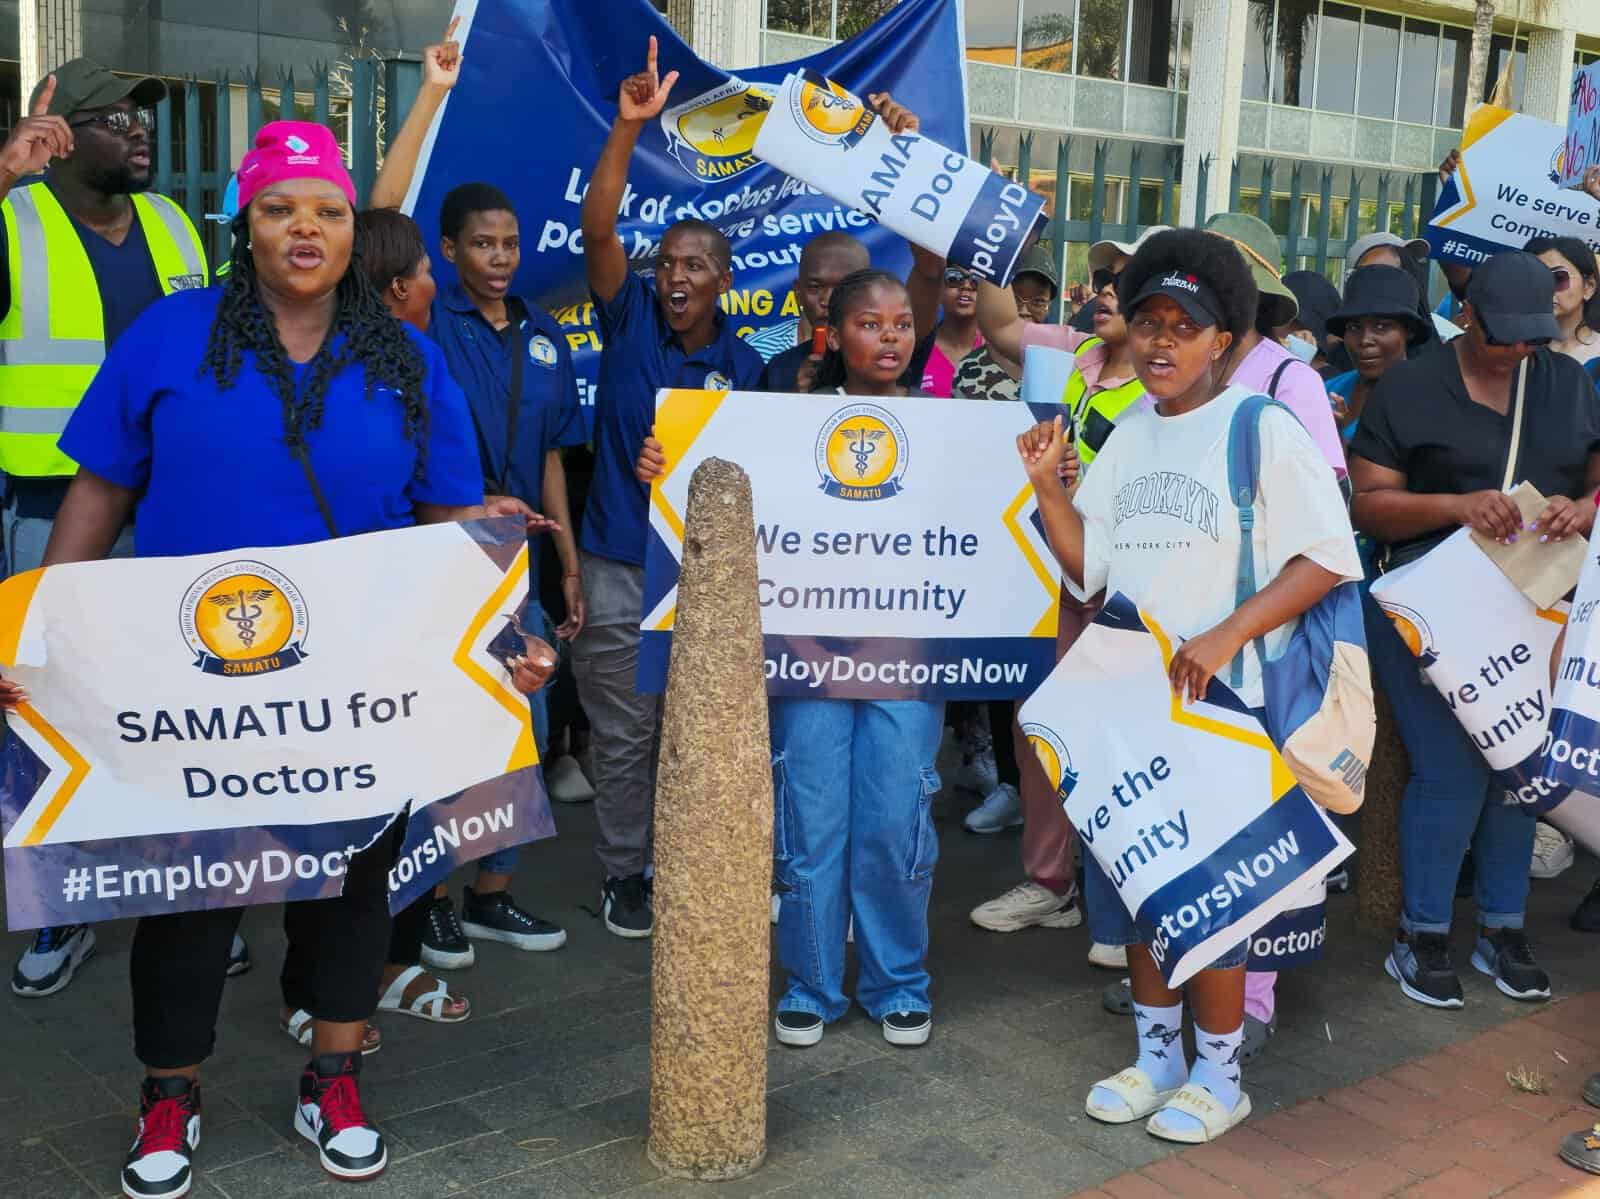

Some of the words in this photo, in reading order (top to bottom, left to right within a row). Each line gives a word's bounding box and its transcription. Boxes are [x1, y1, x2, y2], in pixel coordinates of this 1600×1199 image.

[911, 153, 965, 222] Doc
[1496, 183, 1529, 207] We
[1532, 197, 1591, 225] serve
[640, 194, 672, 224] of
[839, 487, 881, 498] SAMATU
[755, 524, 801, 555] We
[811, 530, 912, 556] serve
[922, 526, 979, 557] the
[1136, 542, 1160, 550] YORK
[1166, 541, 1191, 549] CITY
[758, 578, 966, 620] Community
[223, 656, 280, 674] SAMATU
[1479, 641, 1532, 688] the
[116, 699, 332, 743] SAMATU
[347, 689, 419, 728] for
[1472, 688, 1545, 750] unity
[183, 763, 377, 799] Doctors
[1112, 755, 1171, 808] the
[1110, 809, 1190, 889] unity
